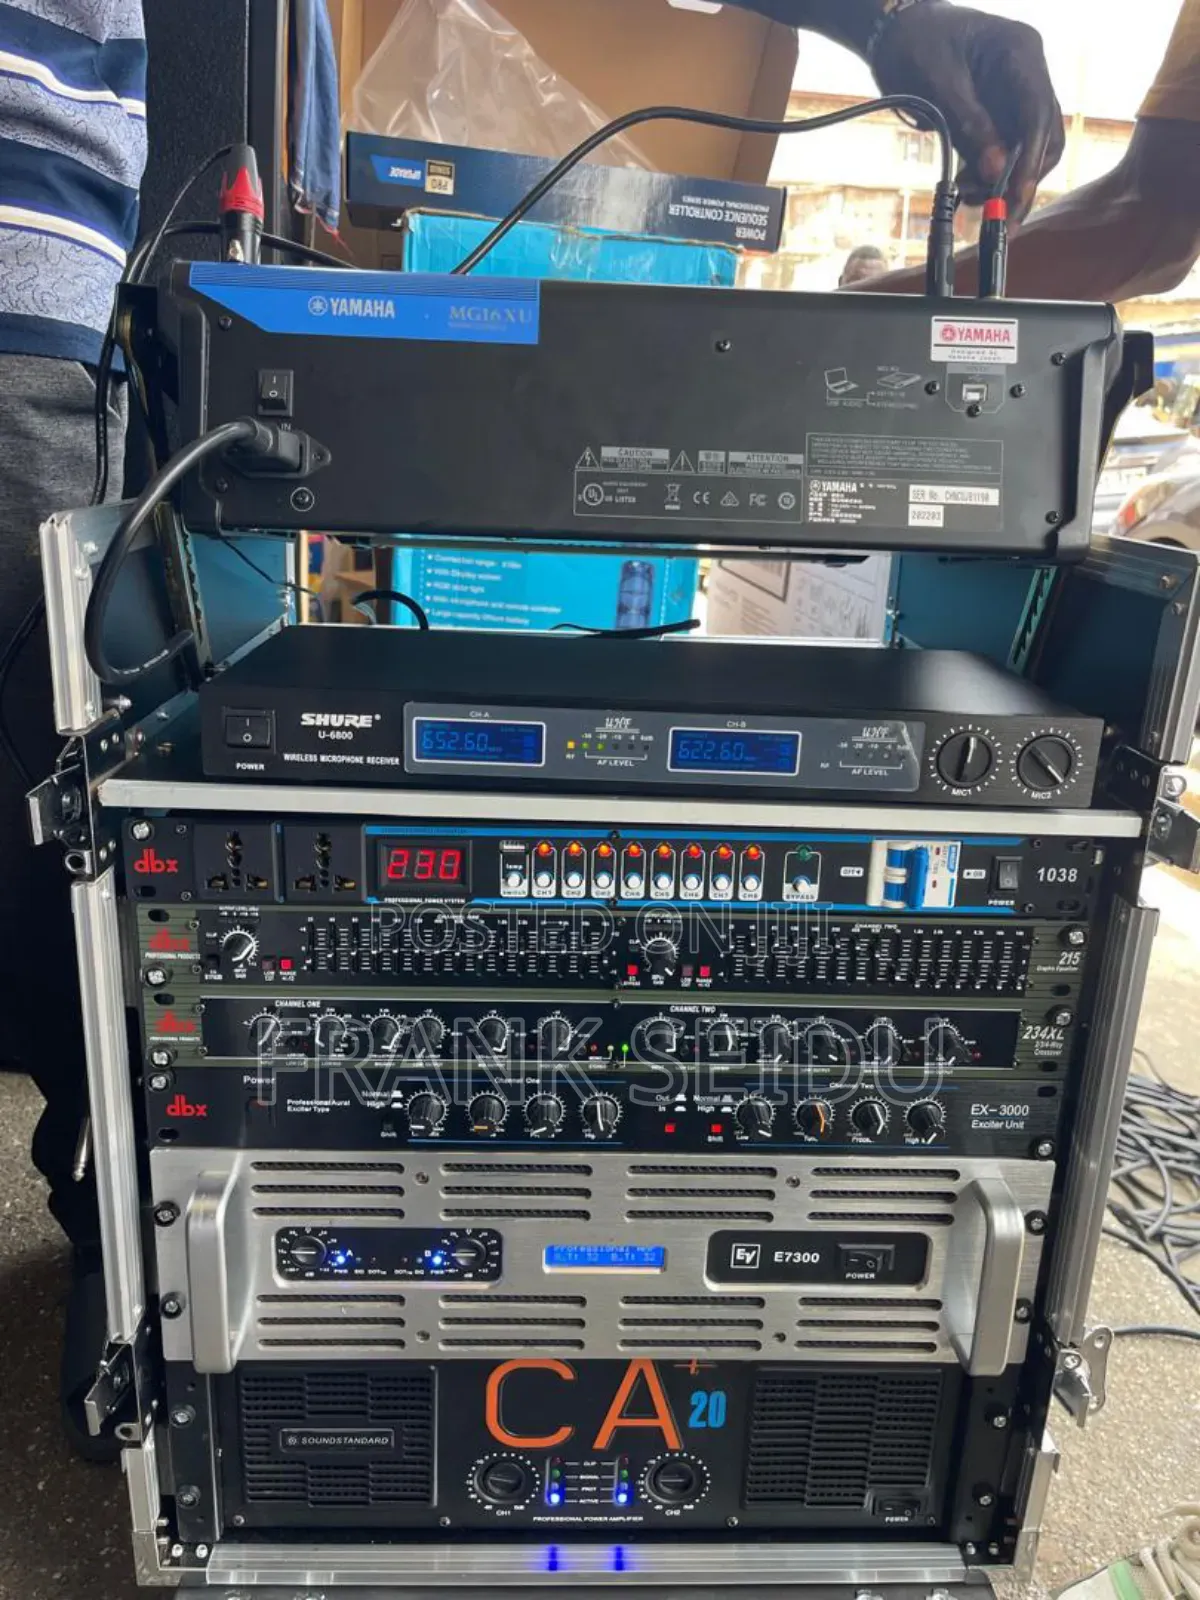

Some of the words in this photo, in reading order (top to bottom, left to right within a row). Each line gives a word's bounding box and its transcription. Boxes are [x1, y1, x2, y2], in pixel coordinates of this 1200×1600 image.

[668, 203, 723, 221] CONTROLLER
[724, 211, 768, 226] SEQUENCE
[735, 226, 767, 240] POWER
[329, 297, 396, 319] YAMAHA
[957, 326, 1010, 343] YAMAHA
[821, 480, 858, 493] YAMAHA
[300, 713, 373, 729] SHURE
[318, 730, 354, 741] U-6800
[283, 752, 318, 763] WIRELESS
[319, 754, 364, 765] MICROPHONE
[366, 755, 400, 766] RECEIVER
[608, 759, 635, 767] LEVEL
[236, 762, 265, 771] POWER
[863, 768, 889, 776] LEVEL
[950, 788, 973, 797] MIC1
[1030, 790, 1053, 800] MIC2
[133, 847, 179, 874] dbx
[387, 848, 462, 879] 230
[1035, 867, 1078, 883] 1038
[987, 899, 1016, 907] POWER
[1059, 951, 1081, 966] 215
[275, 1000, 305, 1008] CHANNEL
[669, 1005, 700, 1013] CHANNEL
[1021, 1025, 1065, 1041] 234XL
[1033, 1048, 1062, 1056] Crossover
[243, 1075, 277, 1085] Power
[494, 1076, 524, 1084] Channel
[525, 1076, 541, 1084] One
[829, 1081, 859, 1089] Channel
[860, 1082, 875, 1090] Two
[361, 1090, 391, 1098] Normal
[655, 1094, 670, 1102] Out
[693, 1094, 721, 1102] Normal
[166, 1093, 208, 1118] dbx
[286, 1098, 331, 1107] Professional
[366, 1100, 386, 1110] High
[286, 1105, 312, 1113] Exciter
[312, 1106, 330, 1114] Type
[658, 1105, 667, 1113] In
[697, 1105, 716, 1114] High
[970, 1103, 1030, 1117] EX-3000
[971, 1119, 1004, 1129] Exciter
[1004, 1119, 1025, 1130] Unit
[346, 1249, 353, 1257] A
[773, 1251, 820, 1263] E7300
[845, 1272, 875, 1280] POWER
[688, 1390, 727, 1428] 20
[301, 1436, 389, 1445] SOUNDSTANDARD
[495, 1509, 512, 1517] CH1
[664, 1508, 681, 1517] CH2
